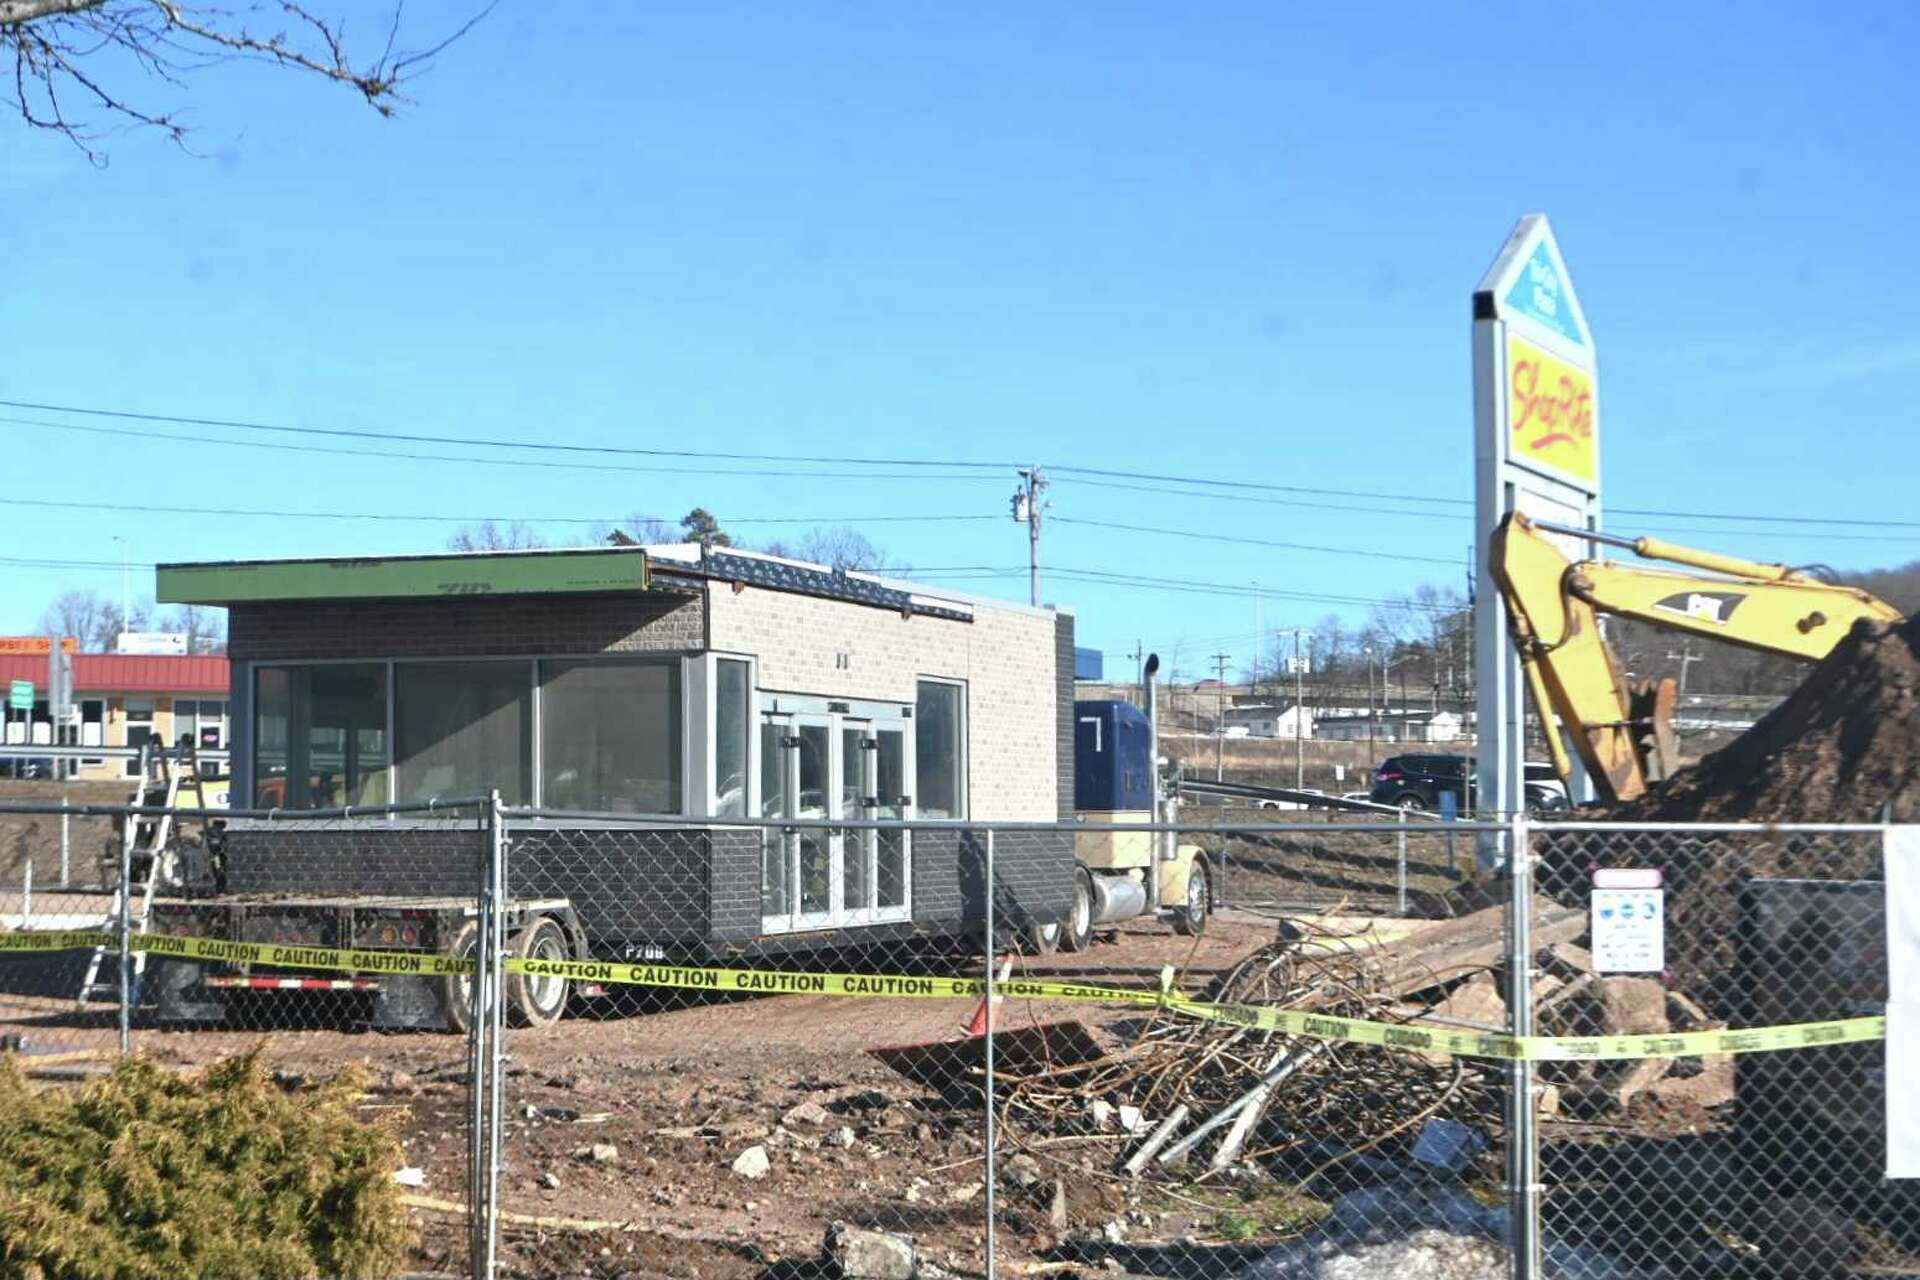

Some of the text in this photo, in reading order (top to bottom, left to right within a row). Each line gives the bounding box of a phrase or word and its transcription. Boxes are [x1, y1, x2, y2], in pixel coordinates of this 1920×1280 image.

[197, 940, 260, 960] CAUTION
[273, 947, 339, 966] CAUTION
[352, 953, 420, 972] CAUTION
[523, 961, 612, 979] CAUTION
[630, 967, 718, 986] CAUTION
[736, 972, 825, 991] CAUTION
[843, 977, 933, 994] CAUTION
